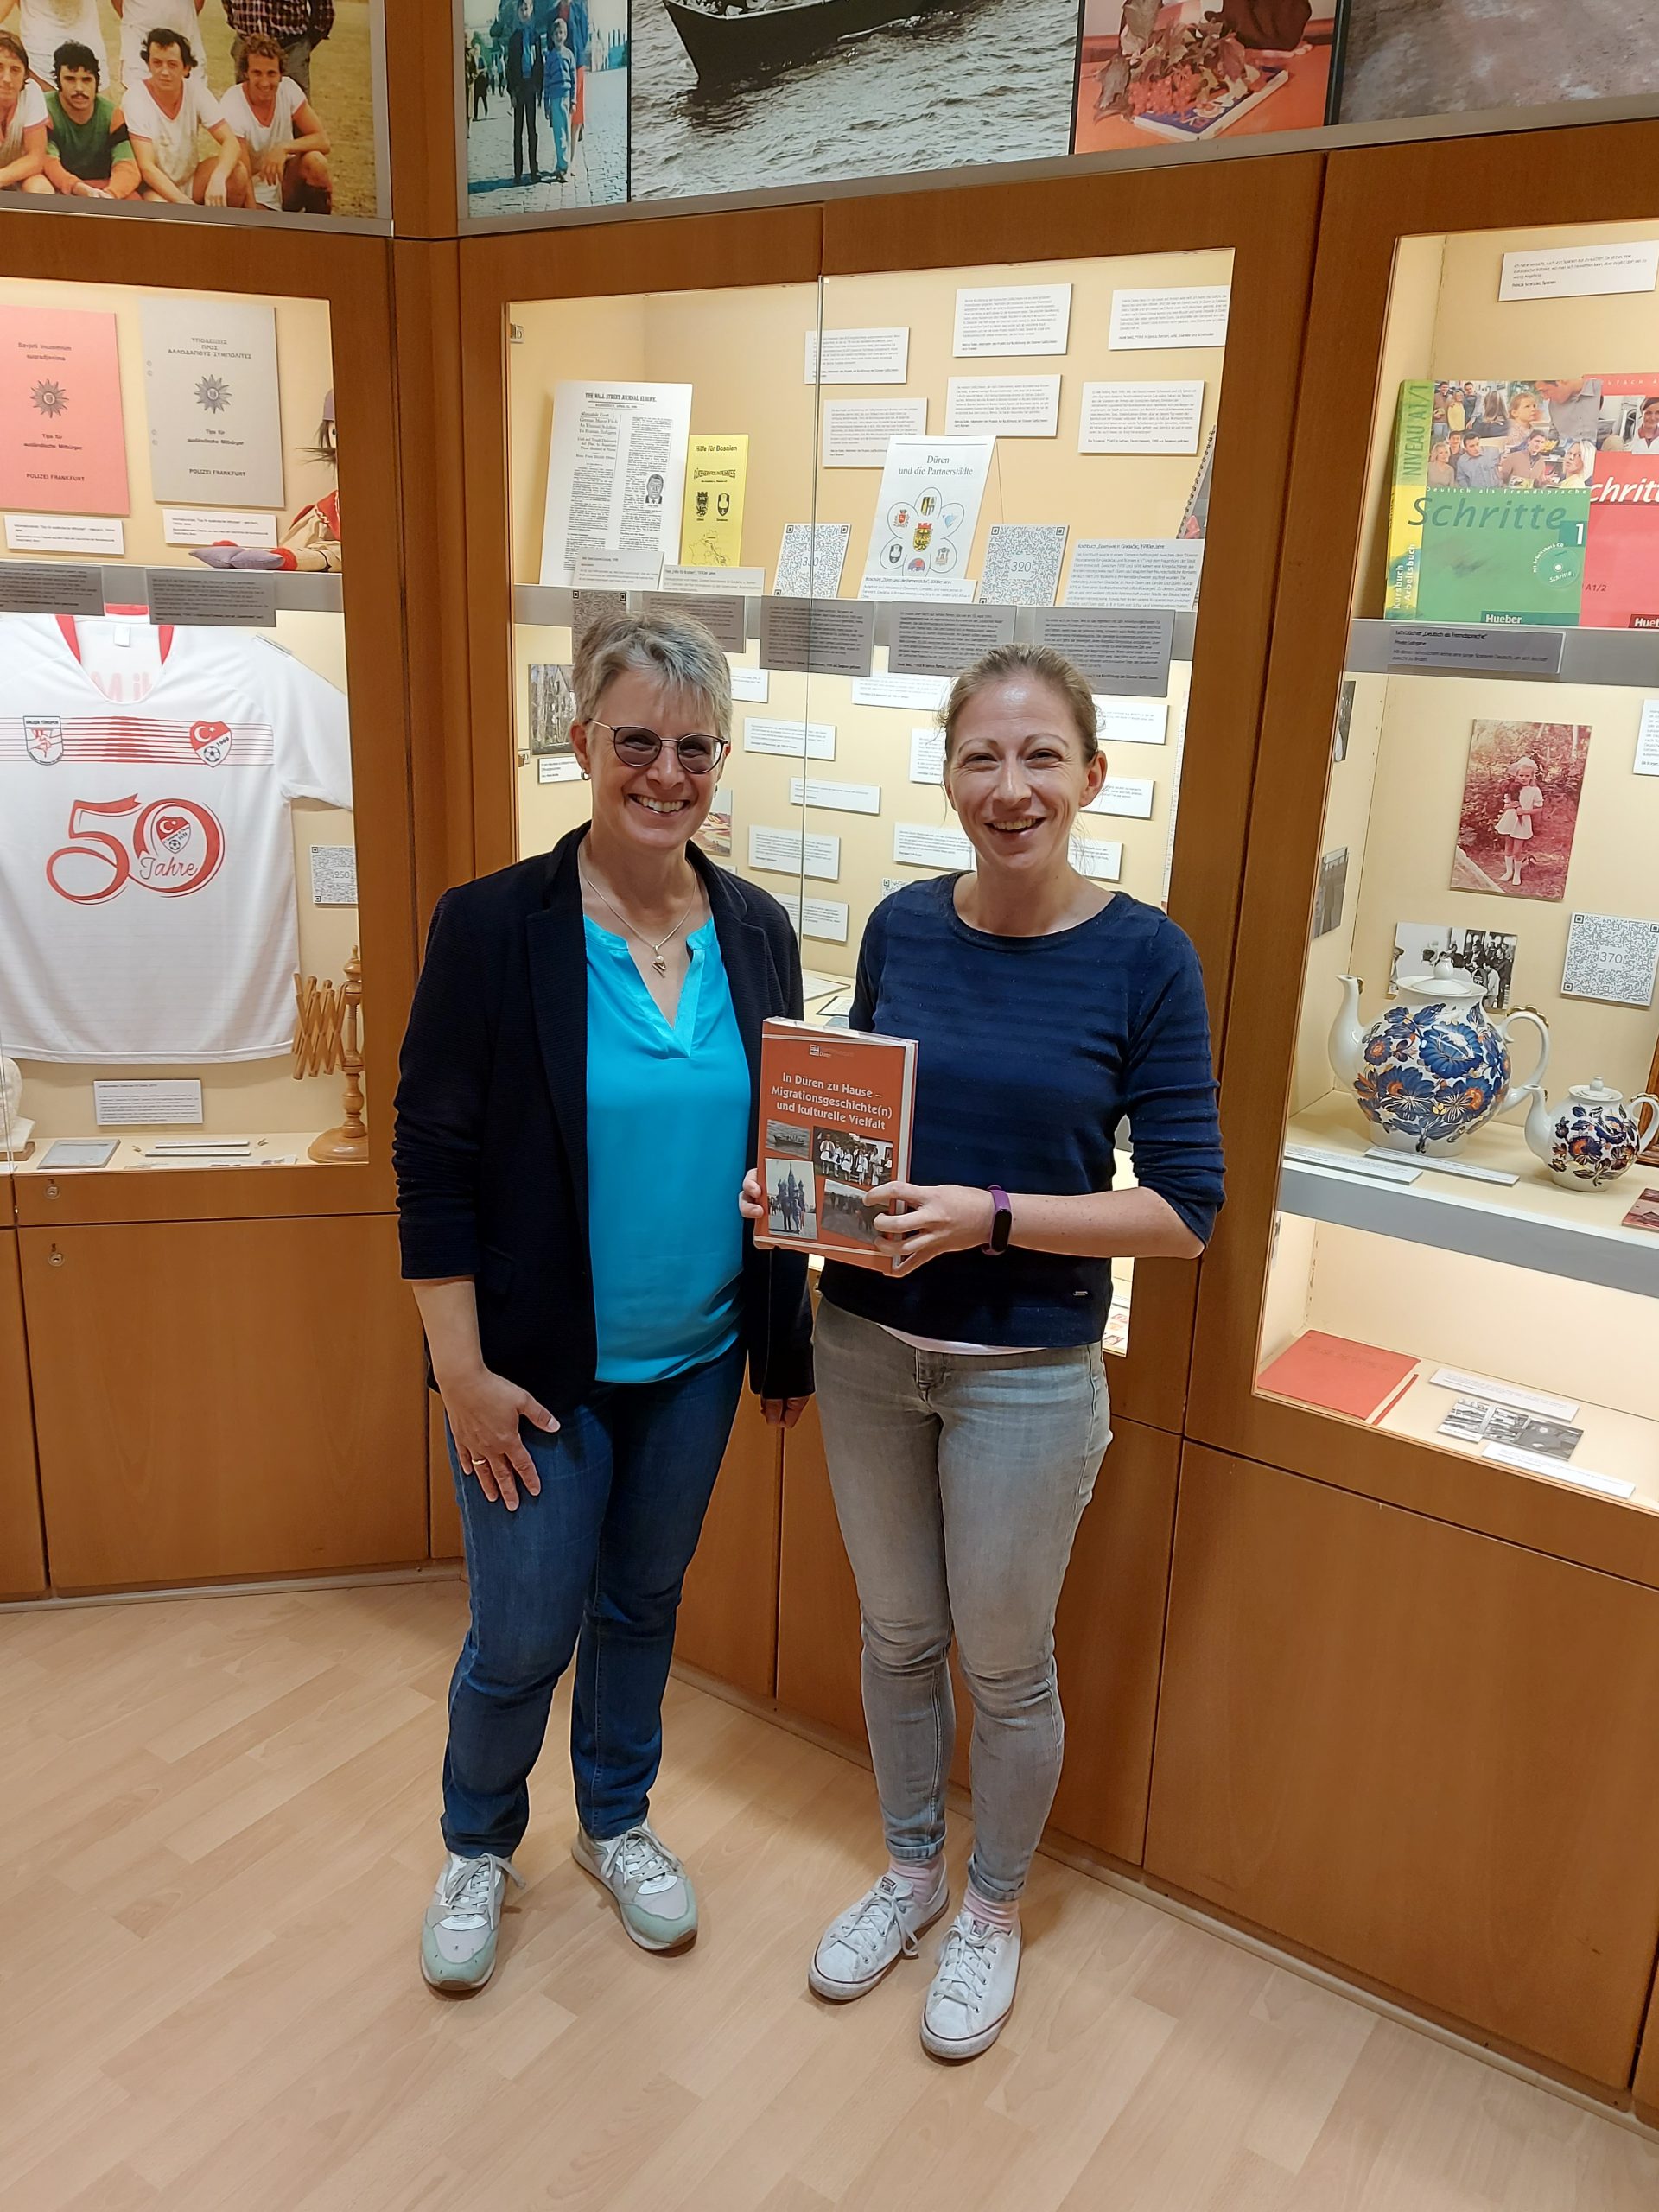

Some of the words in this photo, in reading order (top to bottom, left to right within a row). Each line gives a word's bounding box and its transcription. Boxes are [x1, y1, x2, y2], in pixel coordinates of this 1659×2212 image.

[1410, 385, 1429, 420] A1/1
[926, 455, 950, 464] Düren
[1403, 425, 1425, 476] NIVEAU
[927, 467, 973, 476] Partnerstädte
[1590, 476, 1659, 503] chritt
[1408, 497, 1567, 530] Schritte
[1576, 523, 1584, 545] 1
[1011, 562, 1031, 572] 320
[1404, 543, 1415, 601] Arbeitsbuch
[1393, 564, 1404, 609] Kursbuch
[1485, 614, 1522, 625] Hueber
[1634, 618, 1659, 628] Hue
[47, 793, 226, 905] 50
[140, 856, 198, 880] Jahre
[334, 870, 350, 879] 250
[1599, 951, 1623, 964] 370
[782, 1072, 792, 1084] In
[795, 1075, 824, 1090] Düren
[827, 1083, 839, 1092] zu
[842, 1084, 873, 1098] Hause
[772, 1086, 893, 1119] Migrationsgeschichte(n)
[777, 1102, 796, 1113] und
[798, 1104, 847, 1122] kulturelle
[849, 1114, 886, 1130] Vielfalt
